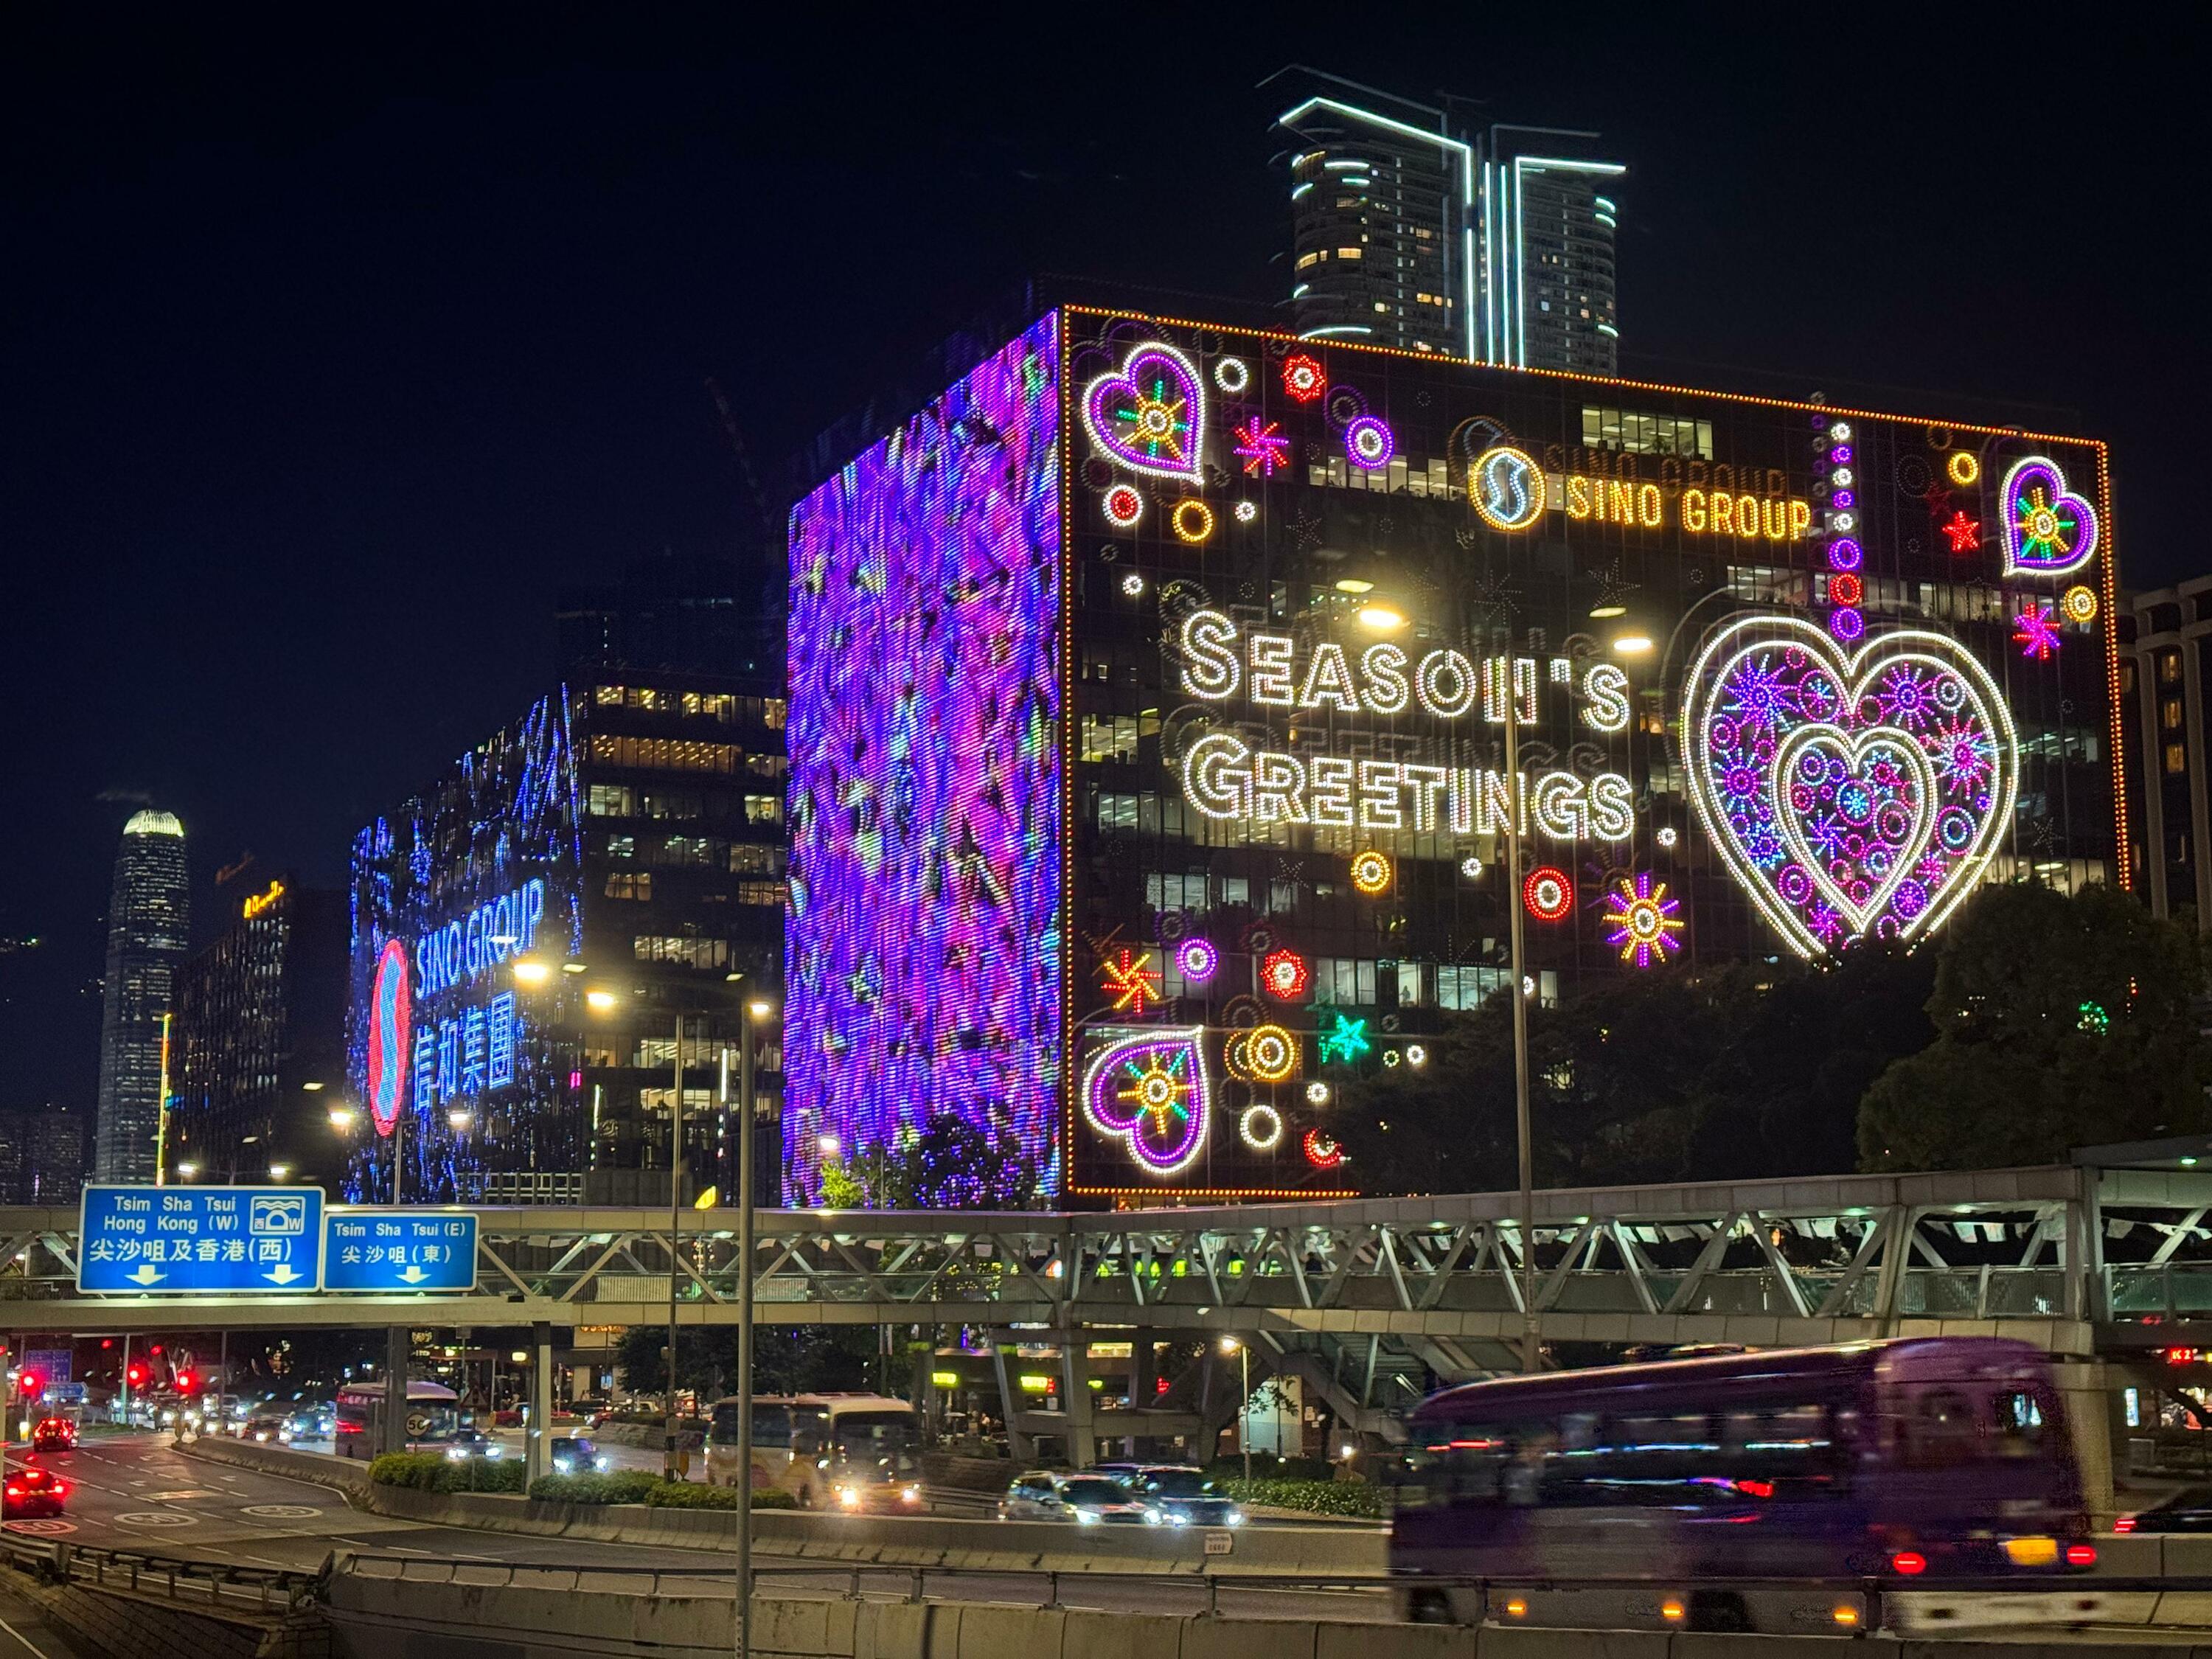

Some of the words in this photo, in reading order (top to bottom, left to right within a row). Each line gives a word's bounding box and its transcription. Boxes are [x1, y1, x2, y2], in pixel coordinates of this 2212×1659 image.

[1566, 475, 1662, 526] SINO
[1683, 489, 1811, 540] GROUP
[1182, 611, 1632, 732] SEASON'S
[1182, 734, 1635, 841] GREETINGS
[416, 921, 462, 1000] SINO
[465, 878, 544, 978] GROUP
[114, 1196, 150, 1211] Tsim
[162, 1196, 192, 1211] Sha
[204, 1196, 236, 1211] Tsui
[104, 1215, 146, 1235] Hong
[157, 1215, 198, 1235] Kong
[209, 1214, 239, 1231] (W)
[288, 1218, 301, 1230] W
[335, 1222, 366, 1237] Tsim
[375, 1222, 401, 1237] Sha
[412, 1222, 439, 1237] Tsui
[444, 1222, 465, 1237] (E)
[89, 1237, 292, 1264] 尖沙咀及香港(西)
[341, 1245, 451, 1264] 尖沙咀(東)
